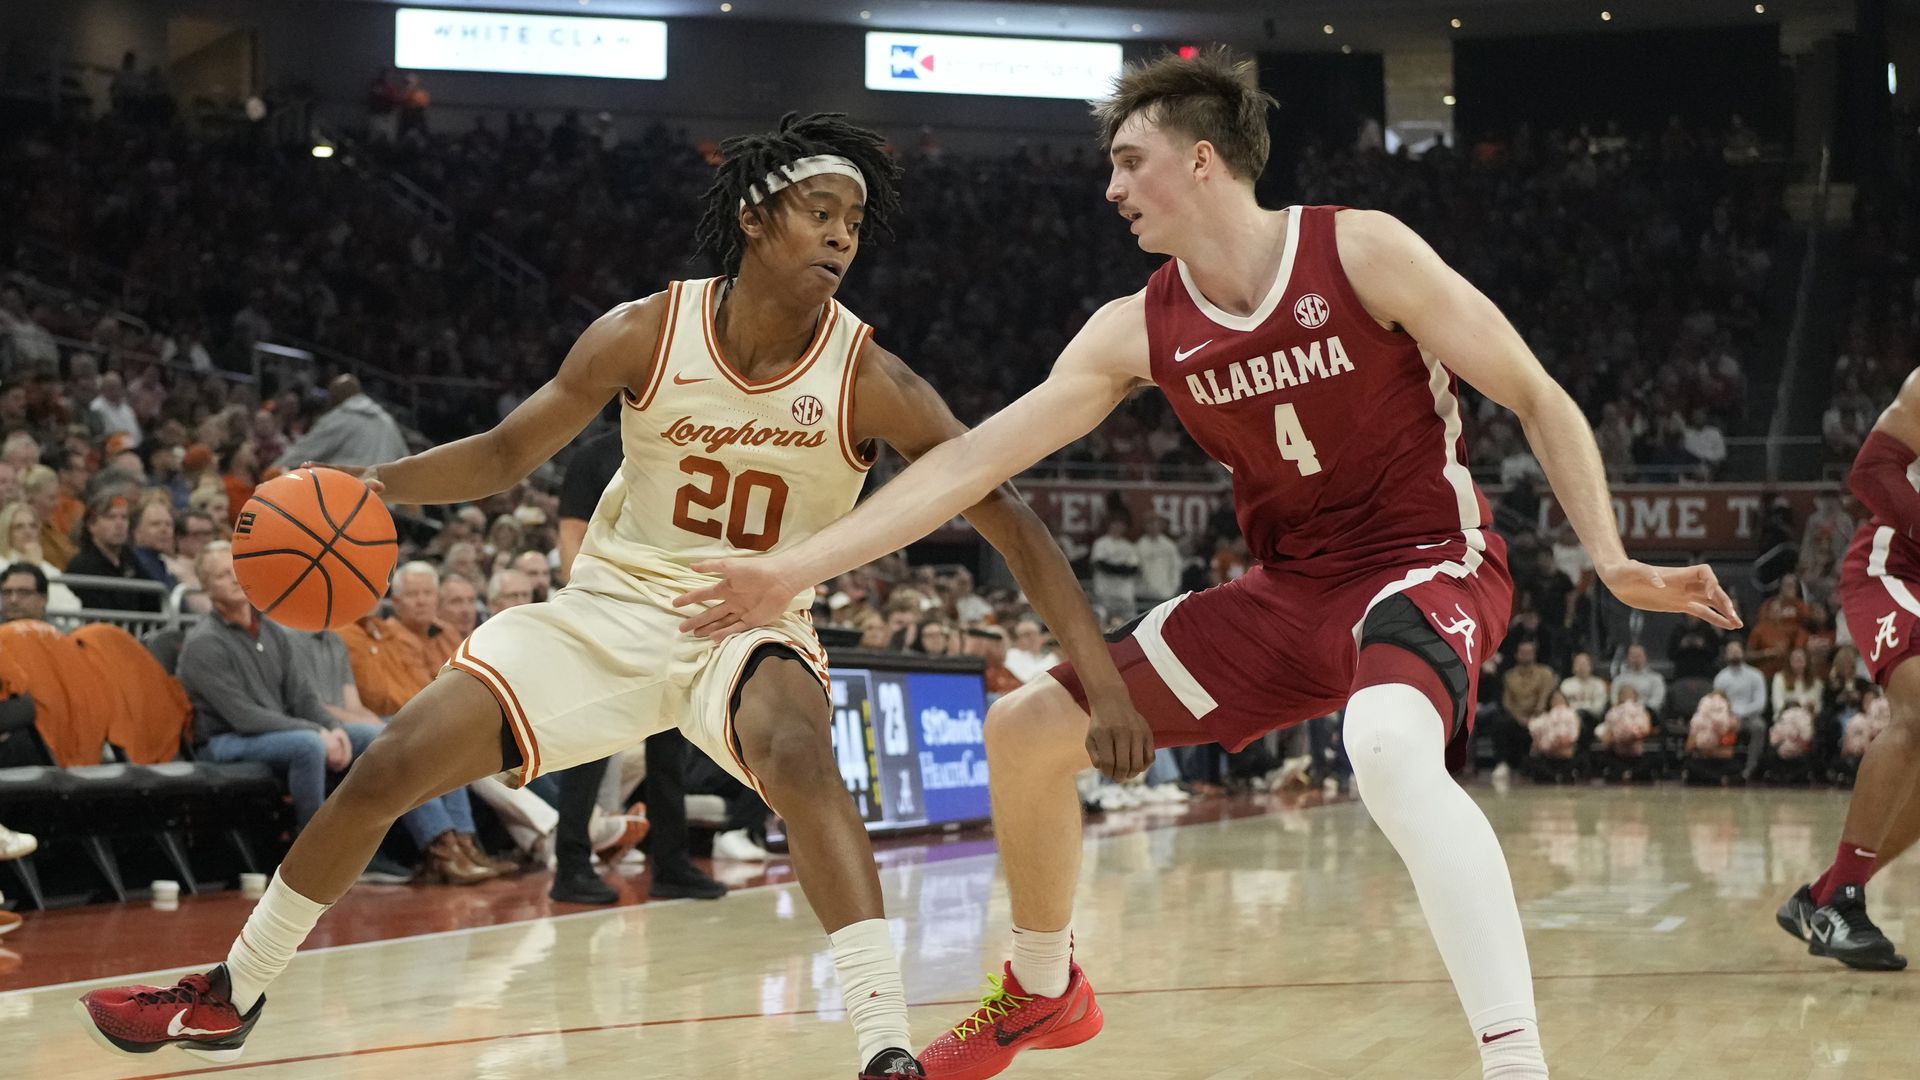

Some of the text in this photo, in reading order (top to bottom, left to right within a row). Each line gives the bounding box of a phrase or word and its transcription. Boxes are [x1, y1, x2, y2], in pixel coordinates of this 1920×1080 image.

[433, 24, 530, 45] WHITE
[1295, 295, 1328, 328] SEC
[1185, 335, 1355, 405] ALABAMA
[792, 396, 823, 425] SEC
[660, 415, 828, 454] Longhorns
[1274, 402, 1322, 476] 4
[672, 454, 790, 552] 20
